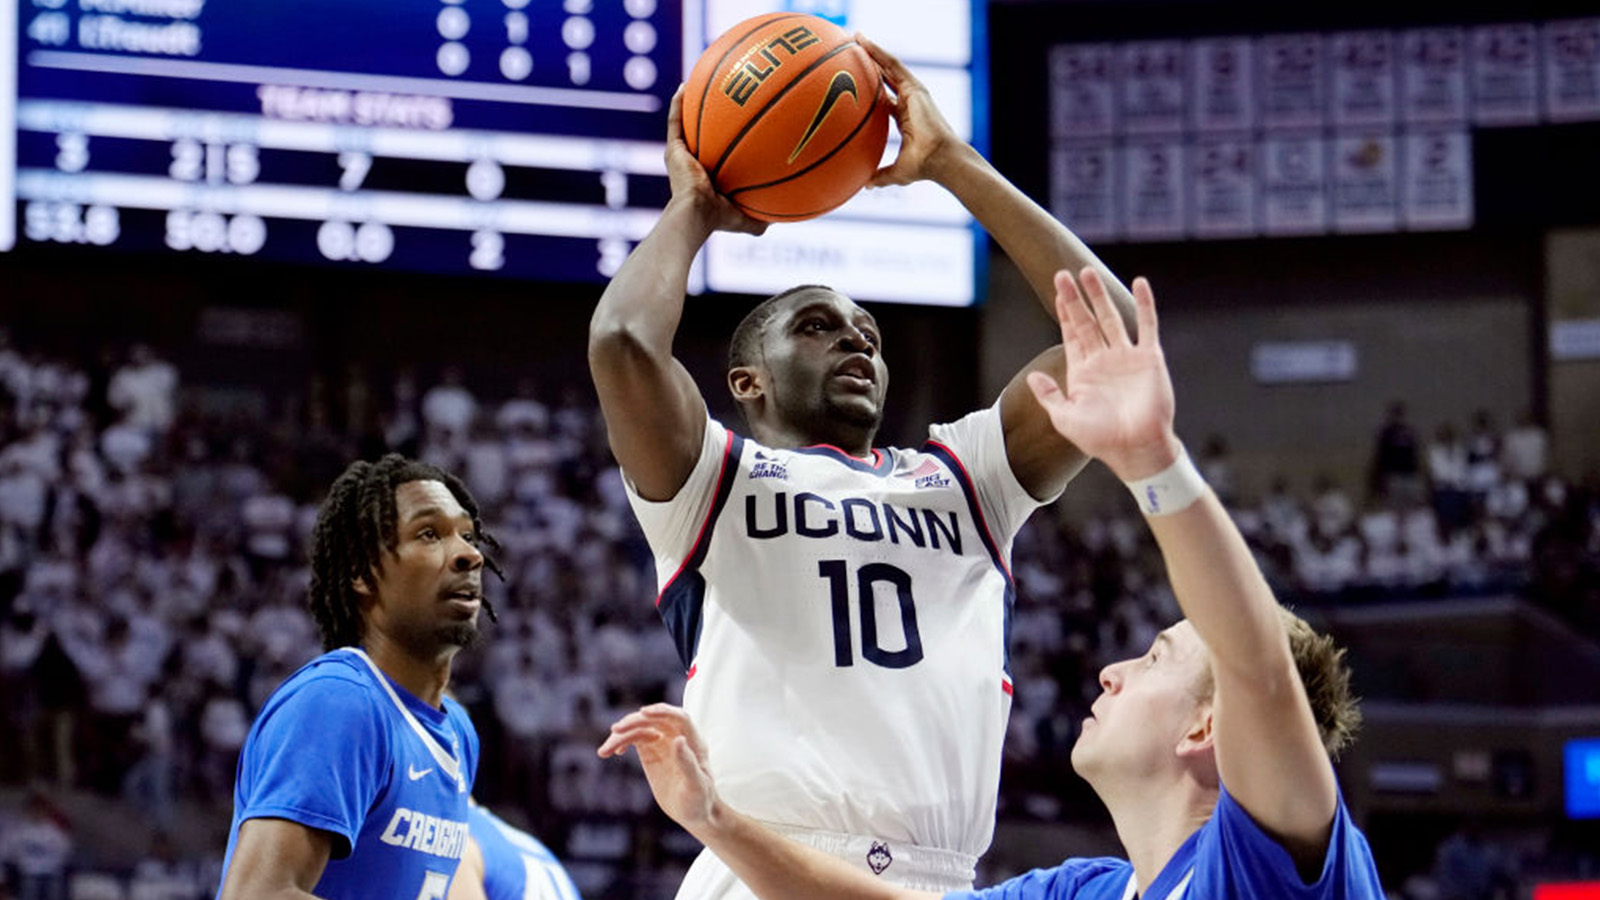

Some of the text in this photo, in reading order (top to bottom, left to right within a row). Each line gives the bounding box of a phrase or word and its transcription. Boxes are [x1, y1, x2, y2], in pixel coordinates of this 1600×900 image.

[724, 25, 821, 107] ELITE
[256, 84, 454, 130] TEAM STATS
[337, 151, 373, 191] 7
[469, 230, 505, 270] 2
[746, 492, 963, 555] UCONN
[818, 560, 924, 669] 10
